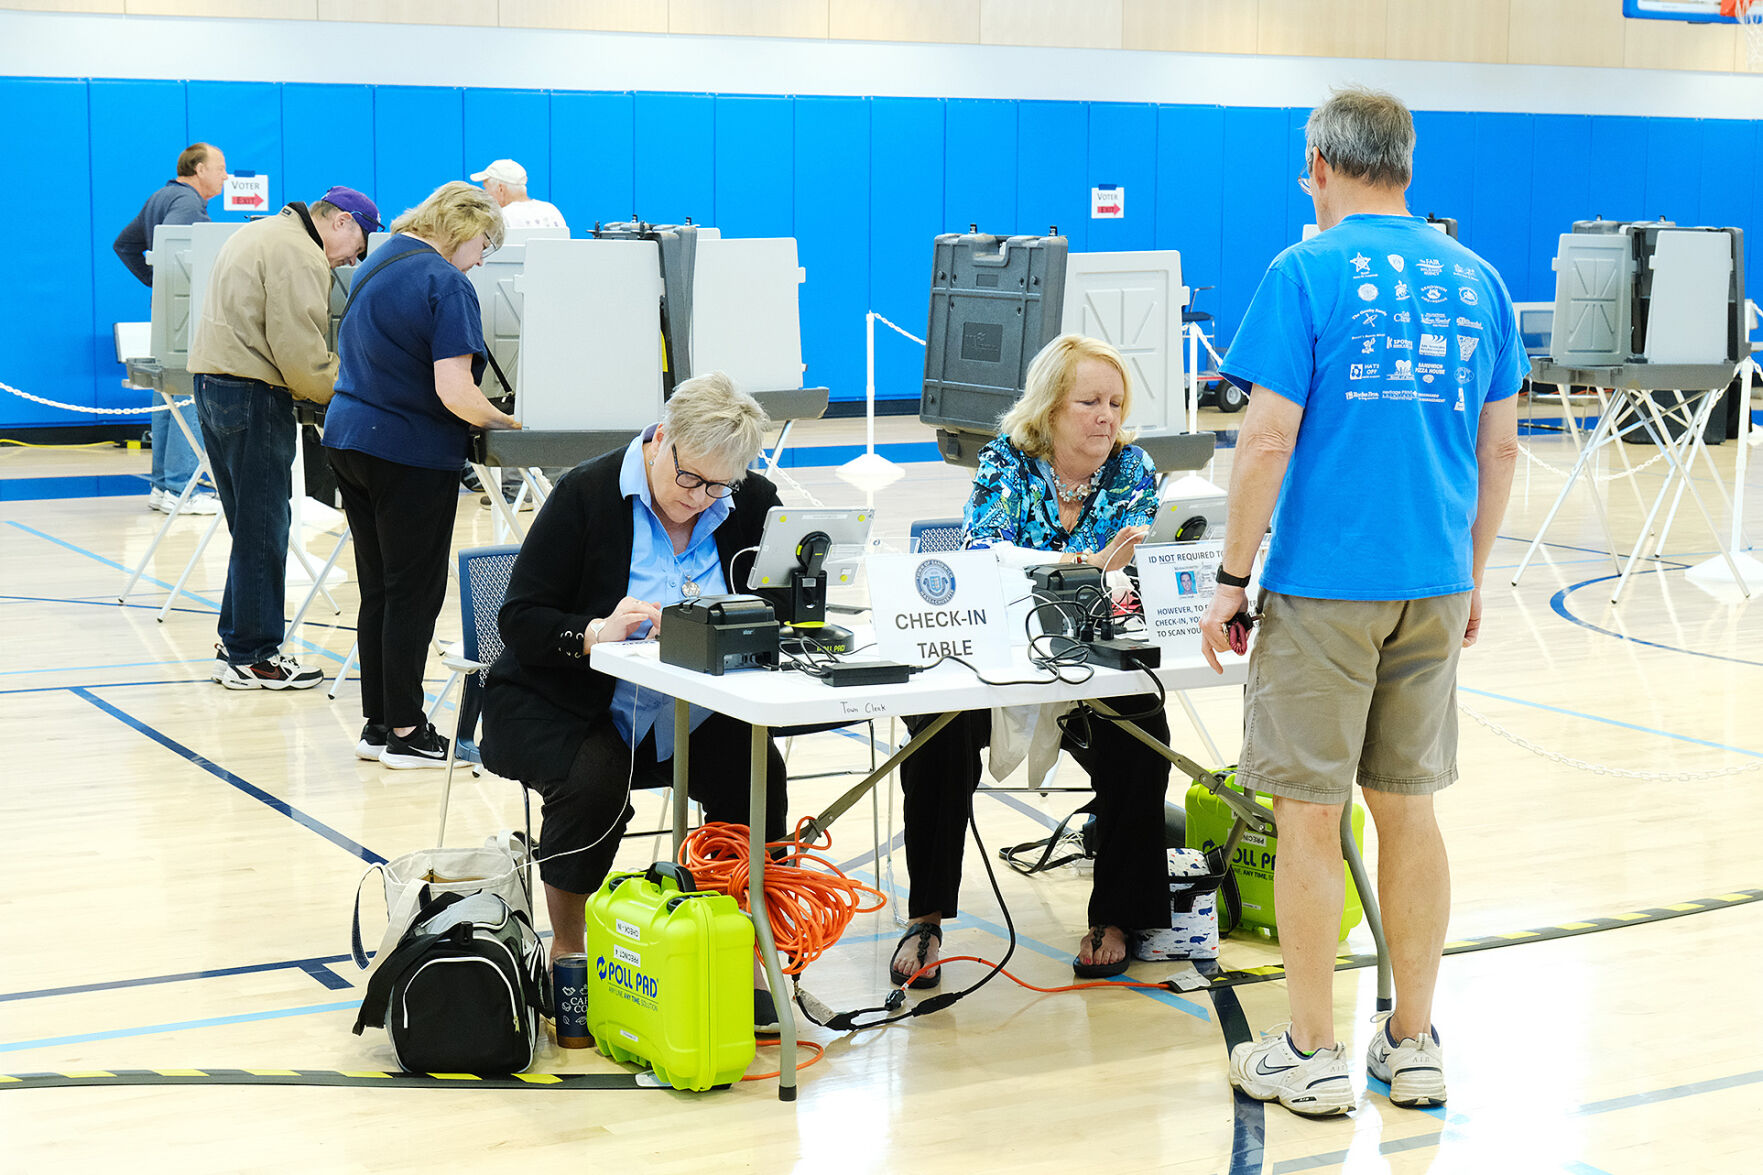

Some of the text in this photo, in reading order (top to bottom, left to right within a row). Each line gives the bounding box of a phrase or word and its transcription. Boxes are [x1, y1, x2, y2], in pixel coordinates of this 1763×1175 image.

[231, 180, 260, 190] VOTER
[1148, 555, 1157, 563] ID
[1159, 554, 1175, 563] NOT
[1177, 551, 1215, 561] REQUIRED
[1157, 606, 1193, 616] HOWEVER,
[895, 609, 987, 630] CHECK-IN
[1155, 616, 1189, 627] CHECK-IN,
[1168, 628, 1186, 637] SCAN
[1187, 627, 1201, 635] YOU
[917, 640, 973, 659] TABLE
[1243, 834, 1265, 845] PRECIN
[1233, 847, 1257, 867] OLL
[608, 961, 658, 998] POLL PAD
[573, 1004, 588, 1014] CO
